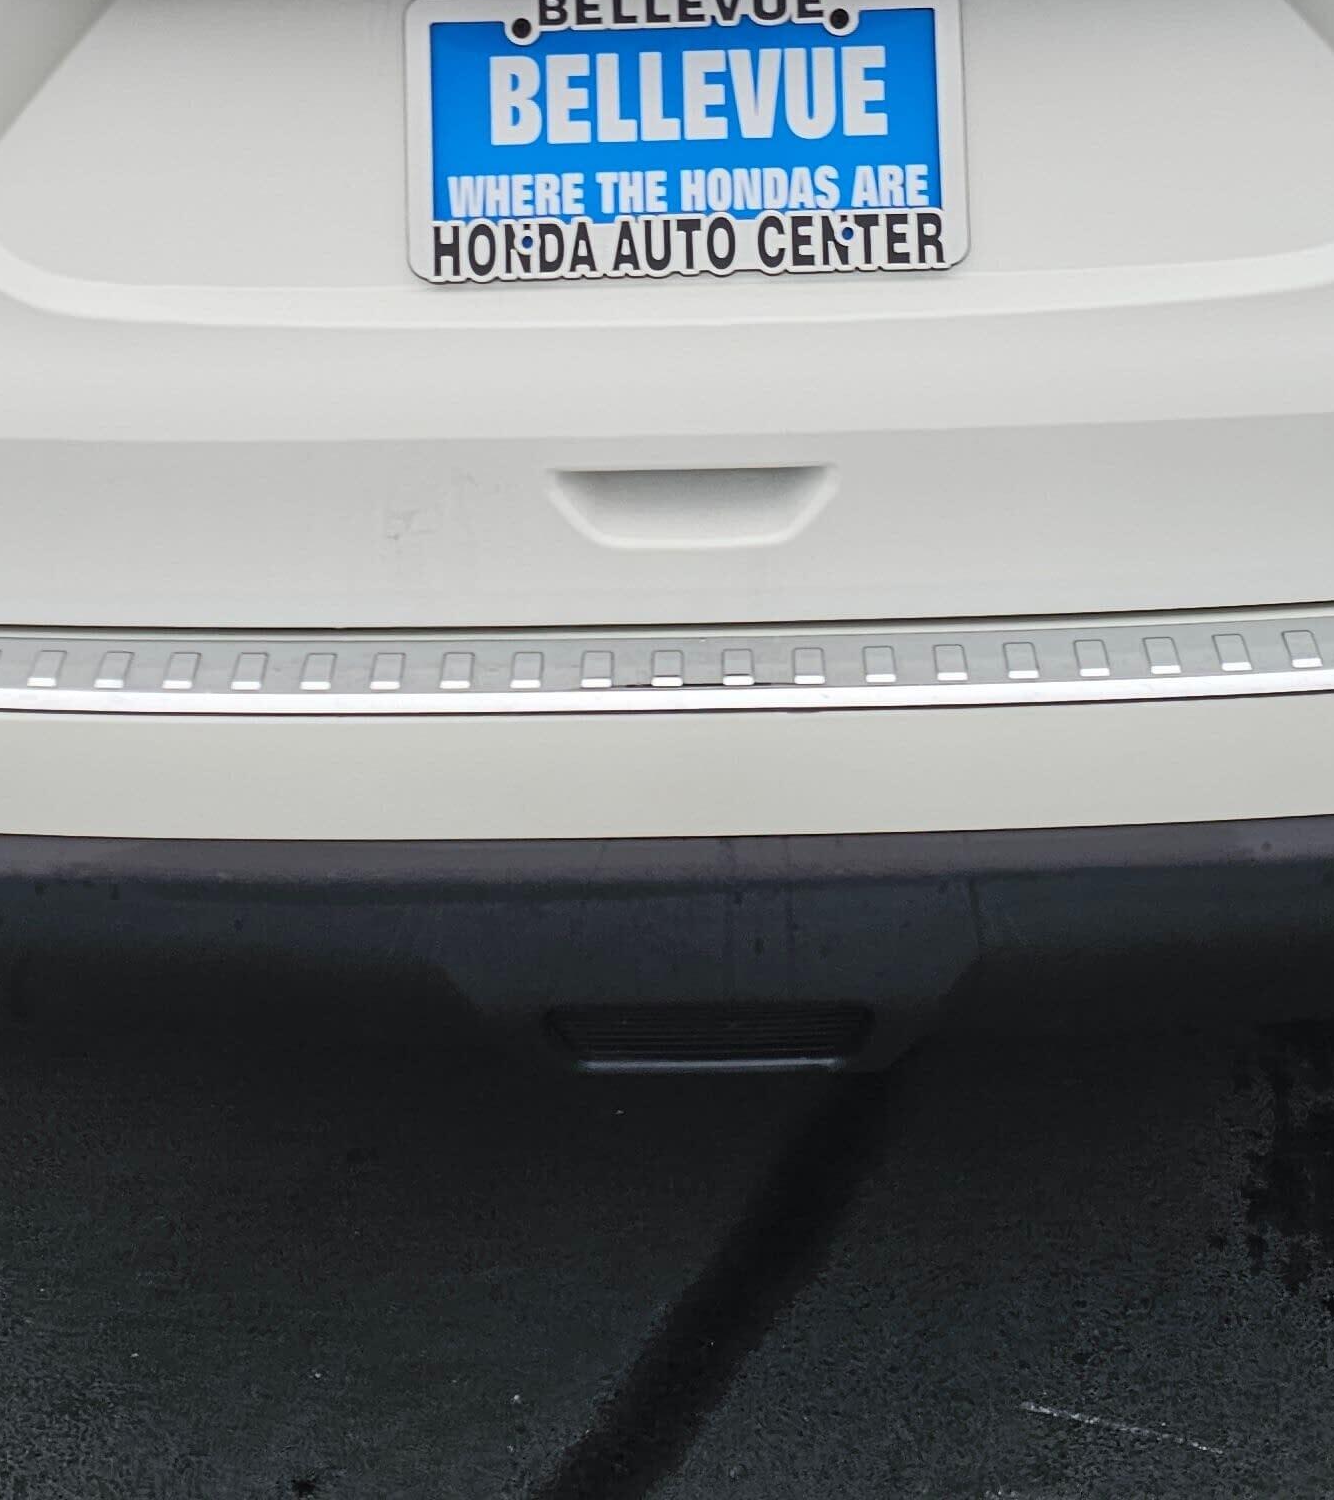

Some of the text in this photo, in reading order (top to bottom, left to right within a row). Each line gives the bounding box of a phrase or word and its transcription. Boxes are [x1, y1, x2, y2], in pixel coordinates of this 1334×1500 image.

[489, 45, 889, 146] BELLEVUE
[447, 163, 929, 218] WHERE THE HONDAS ARE
[432, 212, 947, 278] HONDA AUTO CENTER
